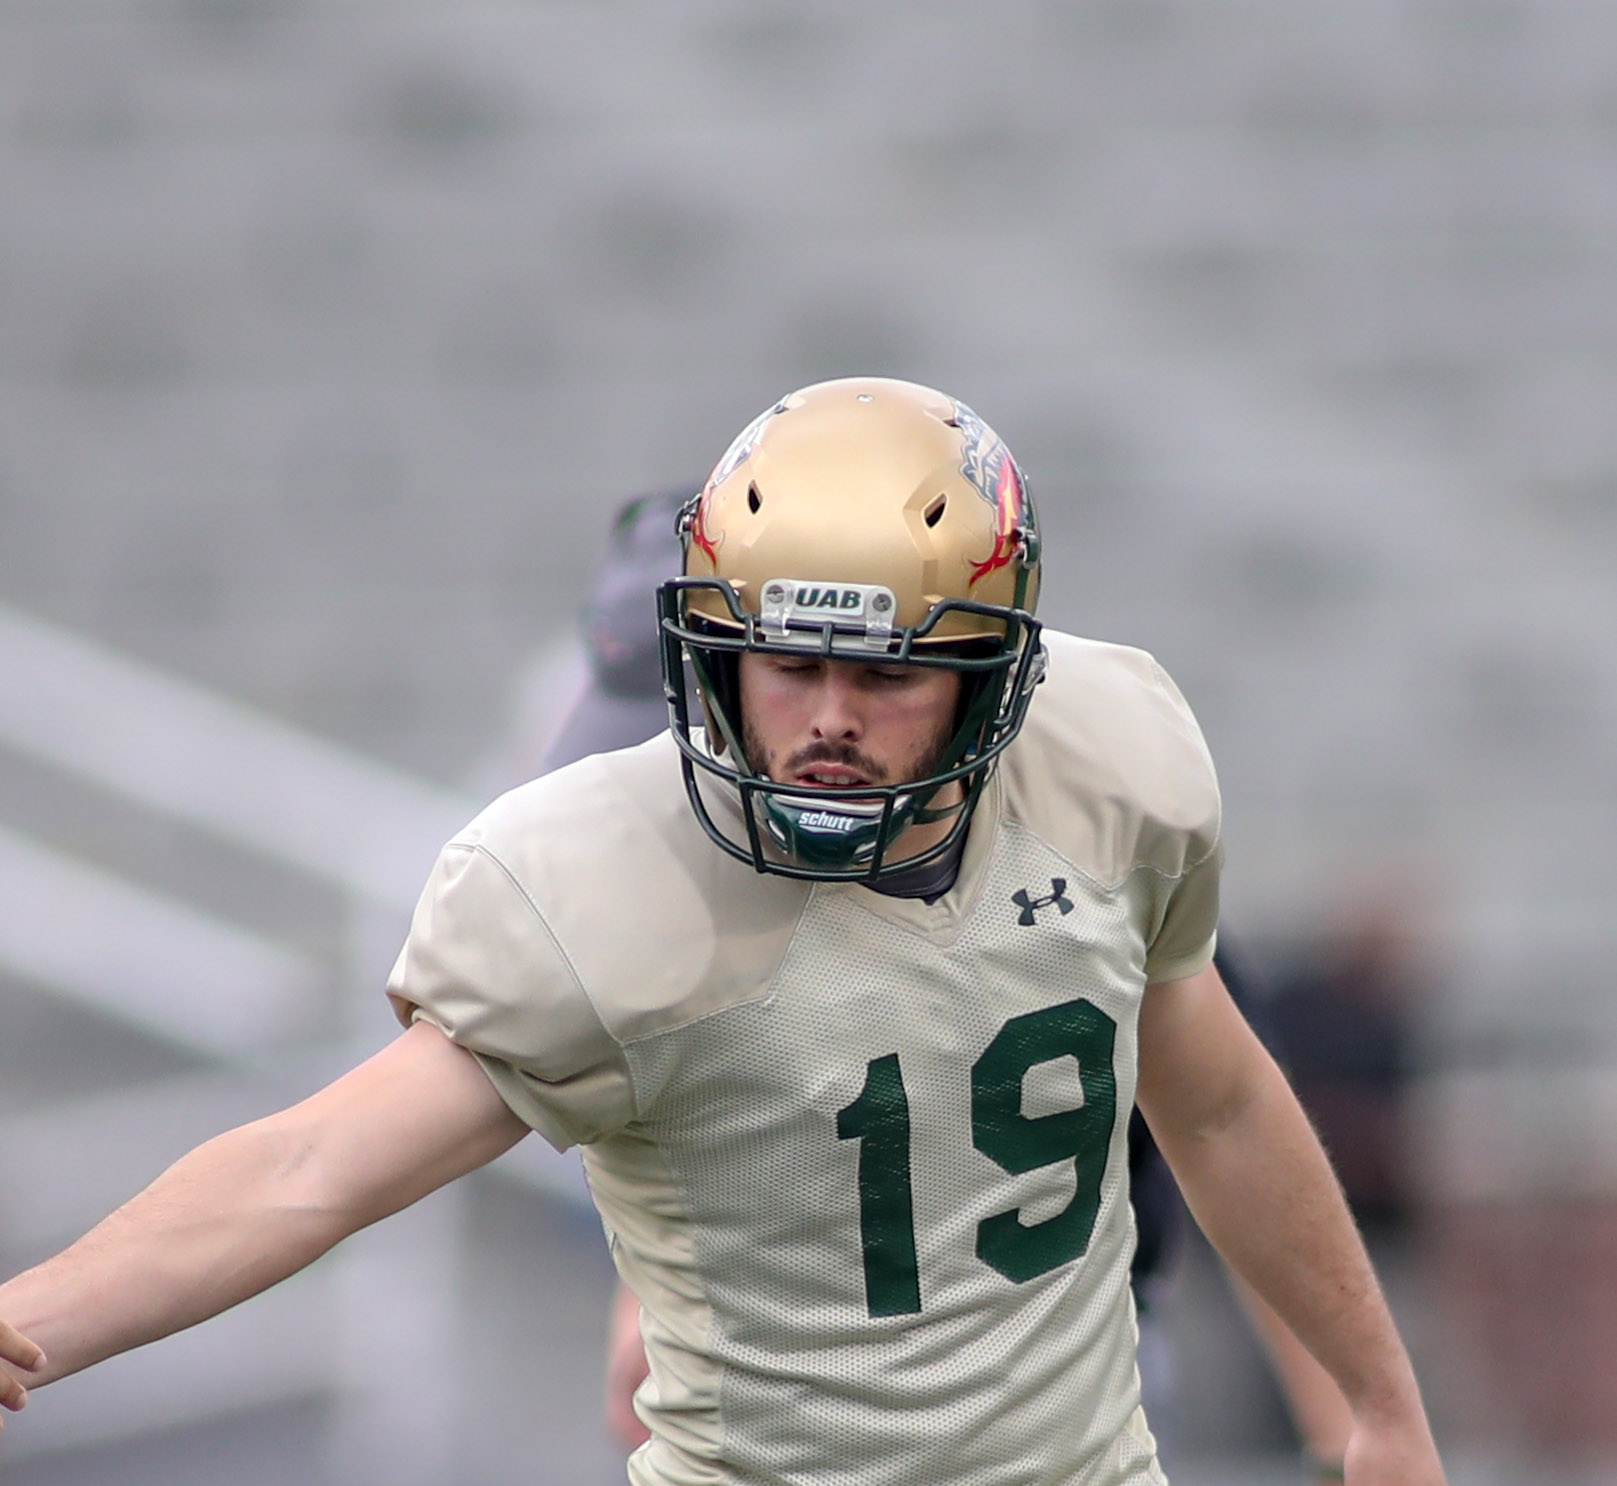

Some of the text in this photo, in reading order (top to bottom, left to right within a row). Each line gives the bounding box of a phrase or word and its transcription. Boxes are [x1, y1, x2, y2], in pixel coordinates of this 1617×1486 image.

[795, 588, 862, 609] UAB
[798, 811, 854, 831] schutt
[836, 998, 1117, 1319] 19
